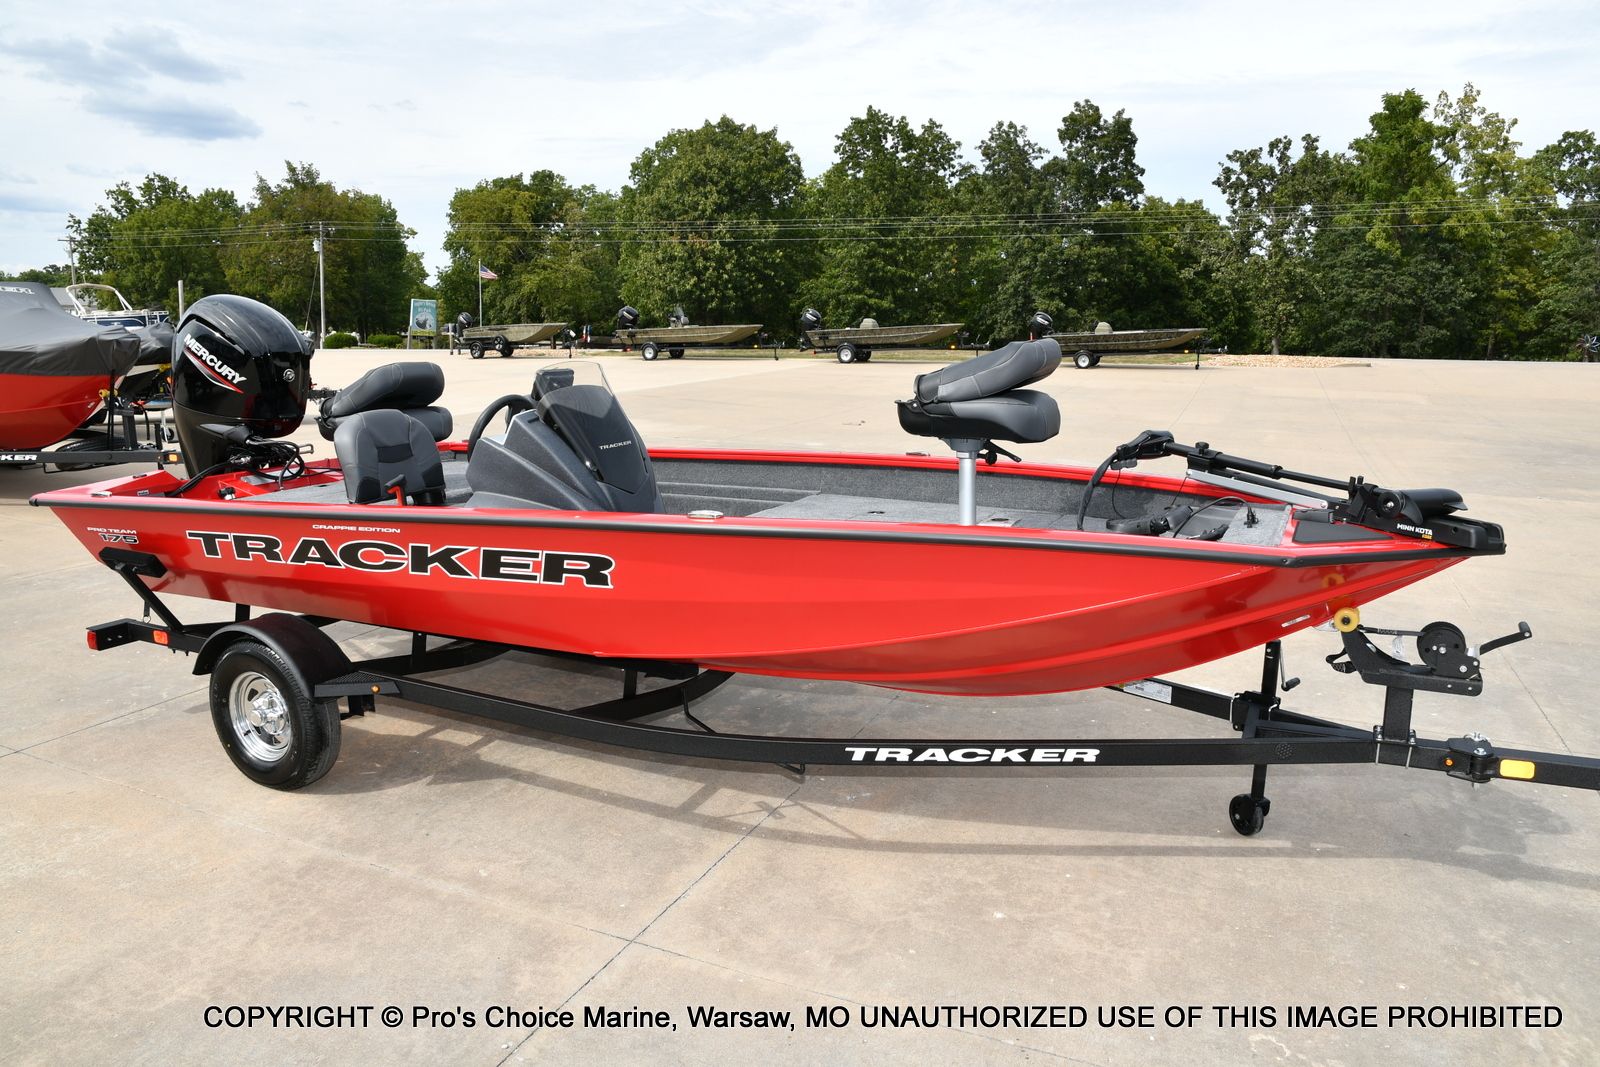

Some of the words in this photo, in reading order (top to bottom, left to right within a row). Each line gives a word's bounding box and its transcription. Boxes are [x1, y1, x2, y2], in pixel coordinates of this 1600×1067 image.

[184, 333, 247, 384] MERCURY
[600, 440, 632, 450] TRACKER
[1397, 523, 1414, 531] MINN
[1415, 527, 1432, 535] KOTA
[98, 533, 139, 544] 175
[186, 530, 615, 590] TRACKER
[845, 747, 1100, 762] TRACKER
